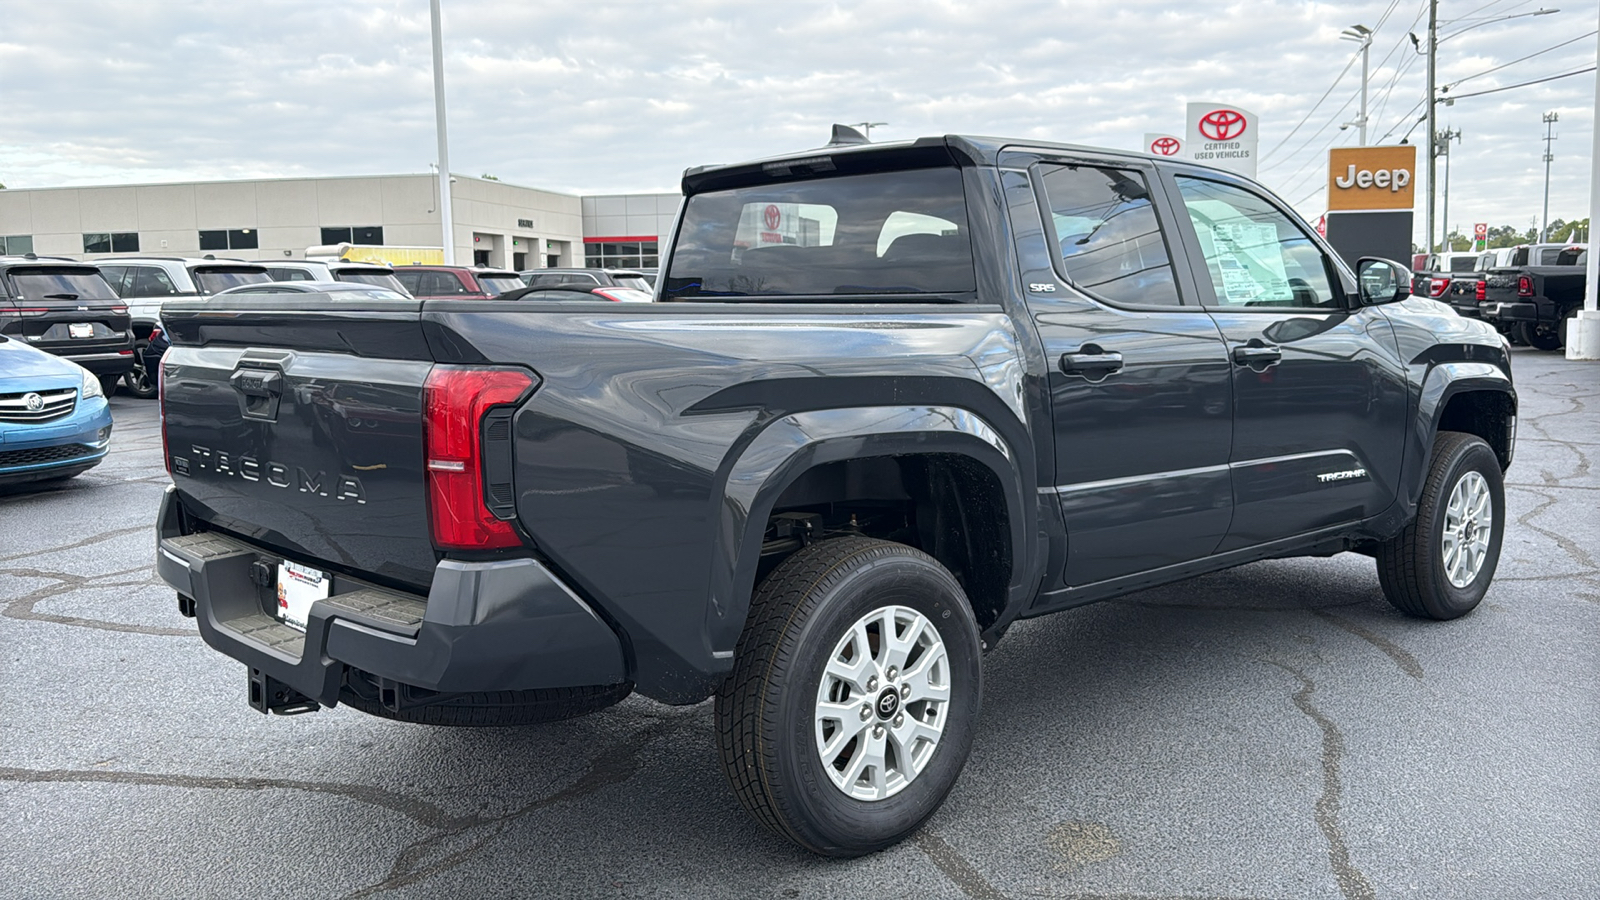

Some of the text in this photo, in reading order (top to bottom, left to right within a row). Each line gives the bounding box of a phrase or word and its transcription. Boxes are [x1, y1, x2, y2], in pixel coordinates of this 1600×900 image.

[1204, 142, 1241, 151] CERTIFIED
[1194, 150, 1250, 160] USED VEHICLES
[1335, 164, 1411, 193] Jeep
[192, 444, 367, 505] TACOMA
[1316, 468, 1366, 483] TACOMA
